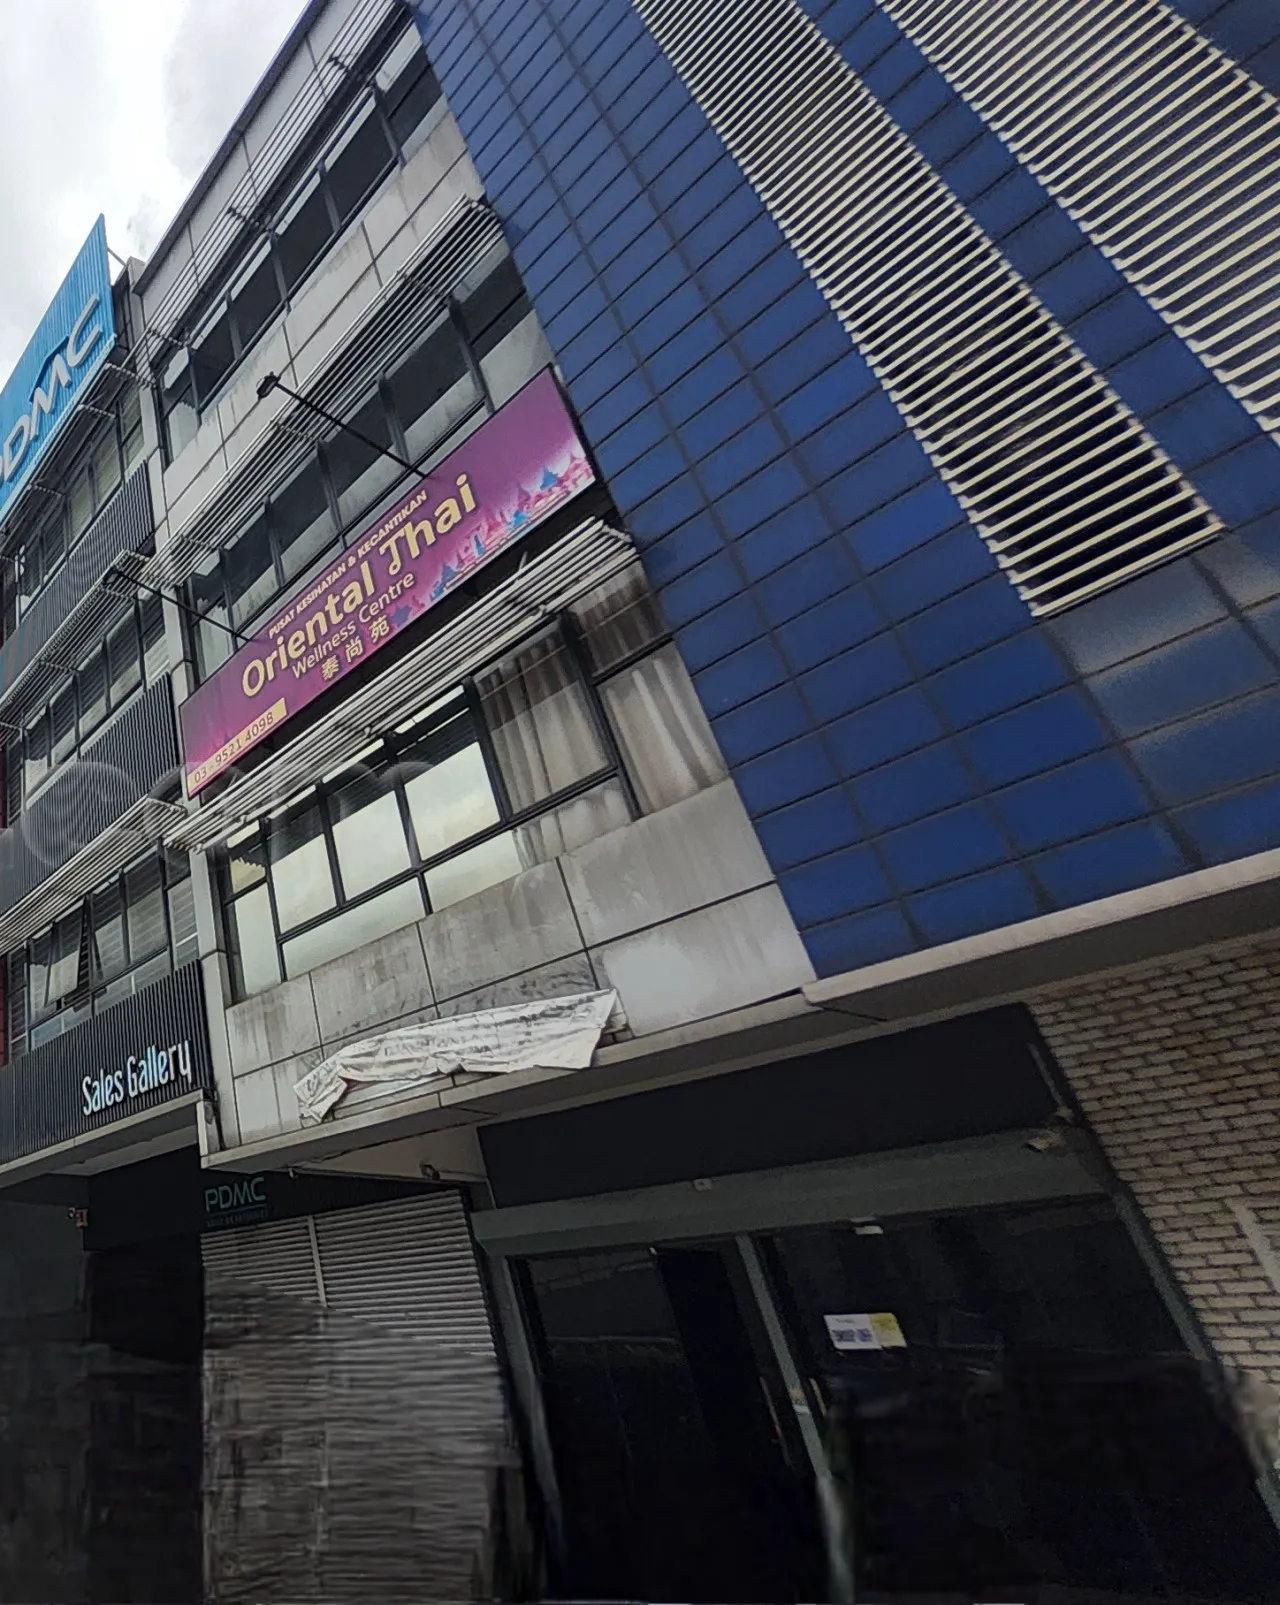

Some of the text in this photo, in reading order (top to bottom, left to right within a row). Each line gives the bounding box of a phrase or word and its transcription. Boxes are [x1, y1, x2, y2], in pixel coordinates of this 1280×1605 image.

[241, 473, 477, 698] Oriental Thai
[269, 490, 427, 639] PUSAT KESIHATAN & KECANTIKAN
[292, 573, 415, 679] Wellness Centre
[245, 711, 274, 742] 4098
[82, 1040, 193, 1116] Sales Gallery
[204, 1177, 267, 1212] PDMC
